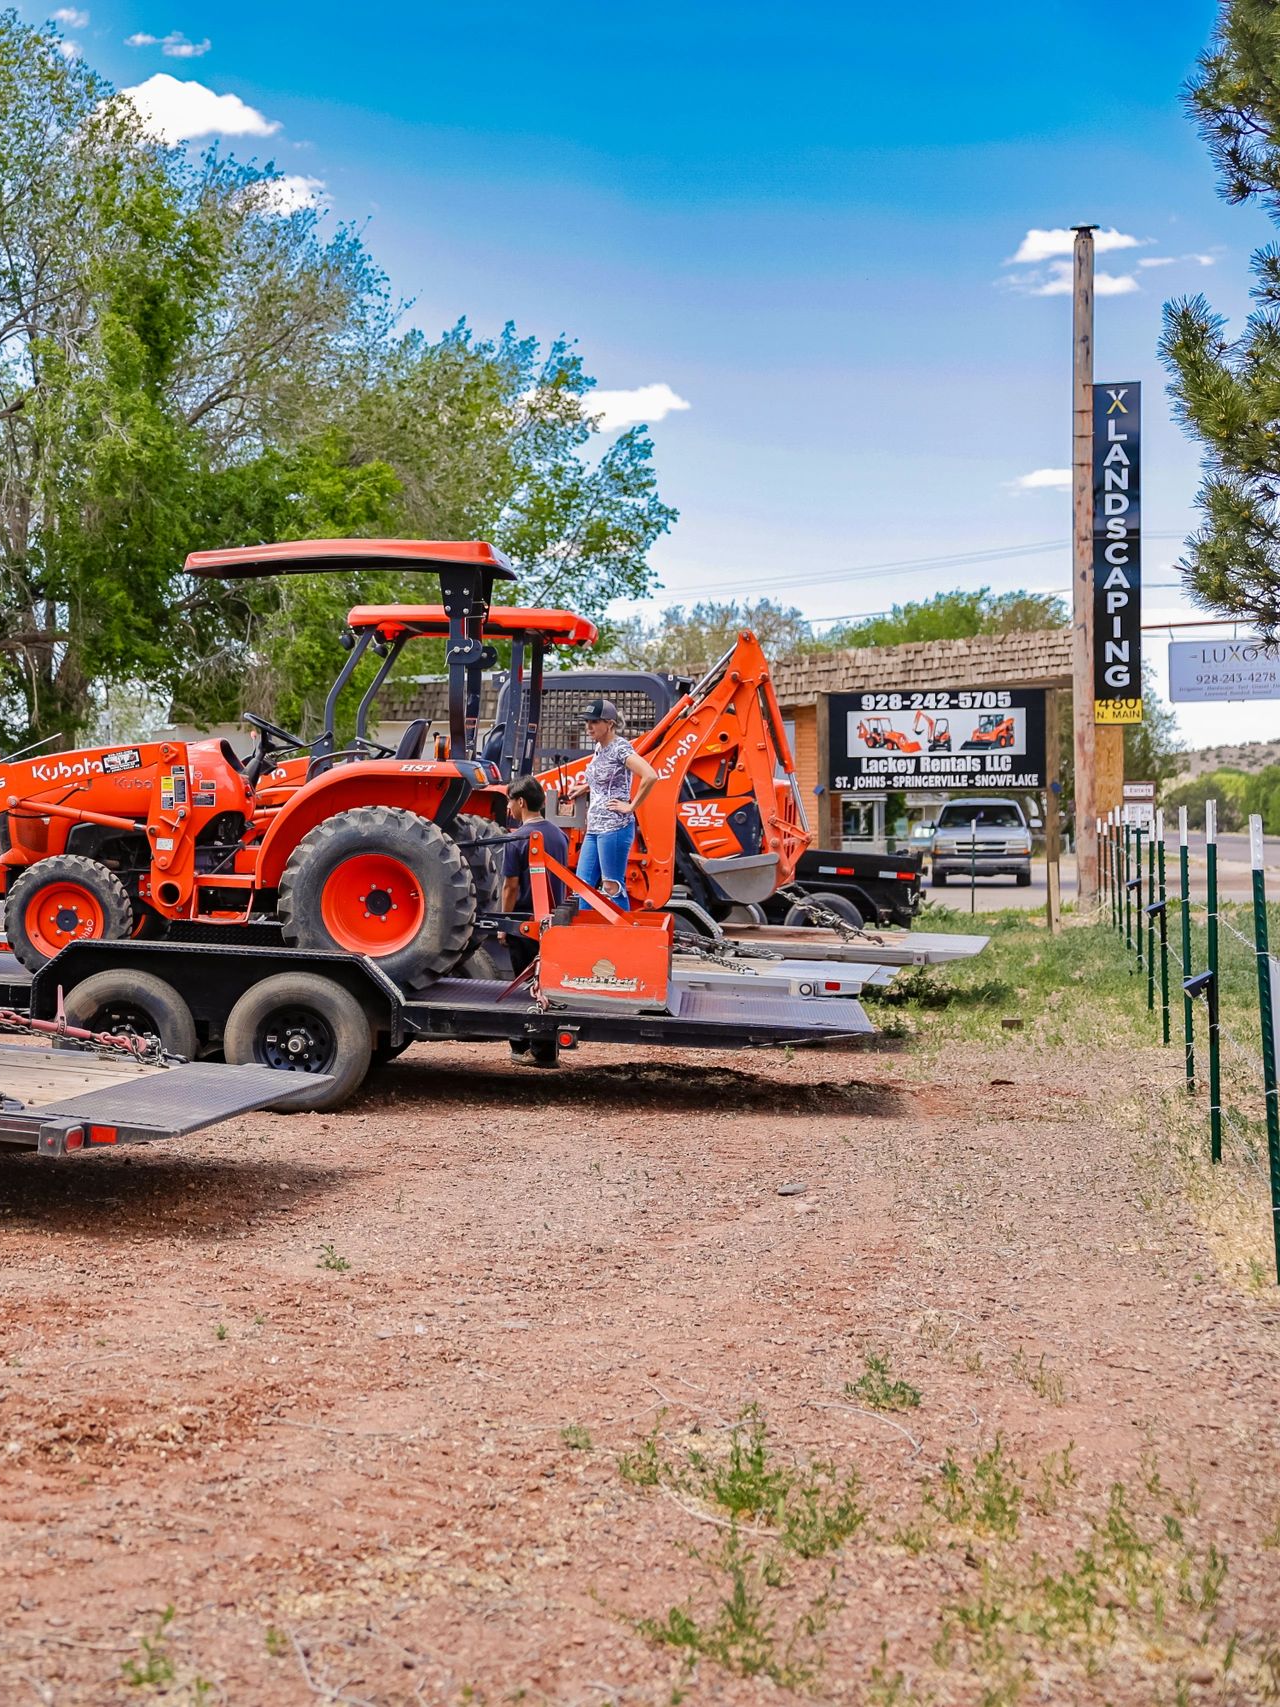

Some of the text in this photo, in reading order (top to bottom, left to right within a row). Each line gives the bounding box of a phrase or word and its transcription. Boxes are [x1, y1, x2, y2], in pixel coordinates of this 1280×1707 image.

[1103, 419, 1131, 688] LANDSCAPING
[1202, 645, 1279, 664] LUXO
[1196, 671, 1277, 685] 928-243-4278
[861, 691, 1012, 710] 928-242-5705
[1112, 710, 1140, 719] MAIN
[656, 733, 698, 781] Kubota
[861, 755, 1012, 774] Lackey Rentals LLC
[32, 757, 103, 782] Kubota
[399, 764, 436, 773] HST
[835, 776, 851, 789] ST.
[679, 803, 726, 816] SVL
[687, 816, 724, 828] 65-2
